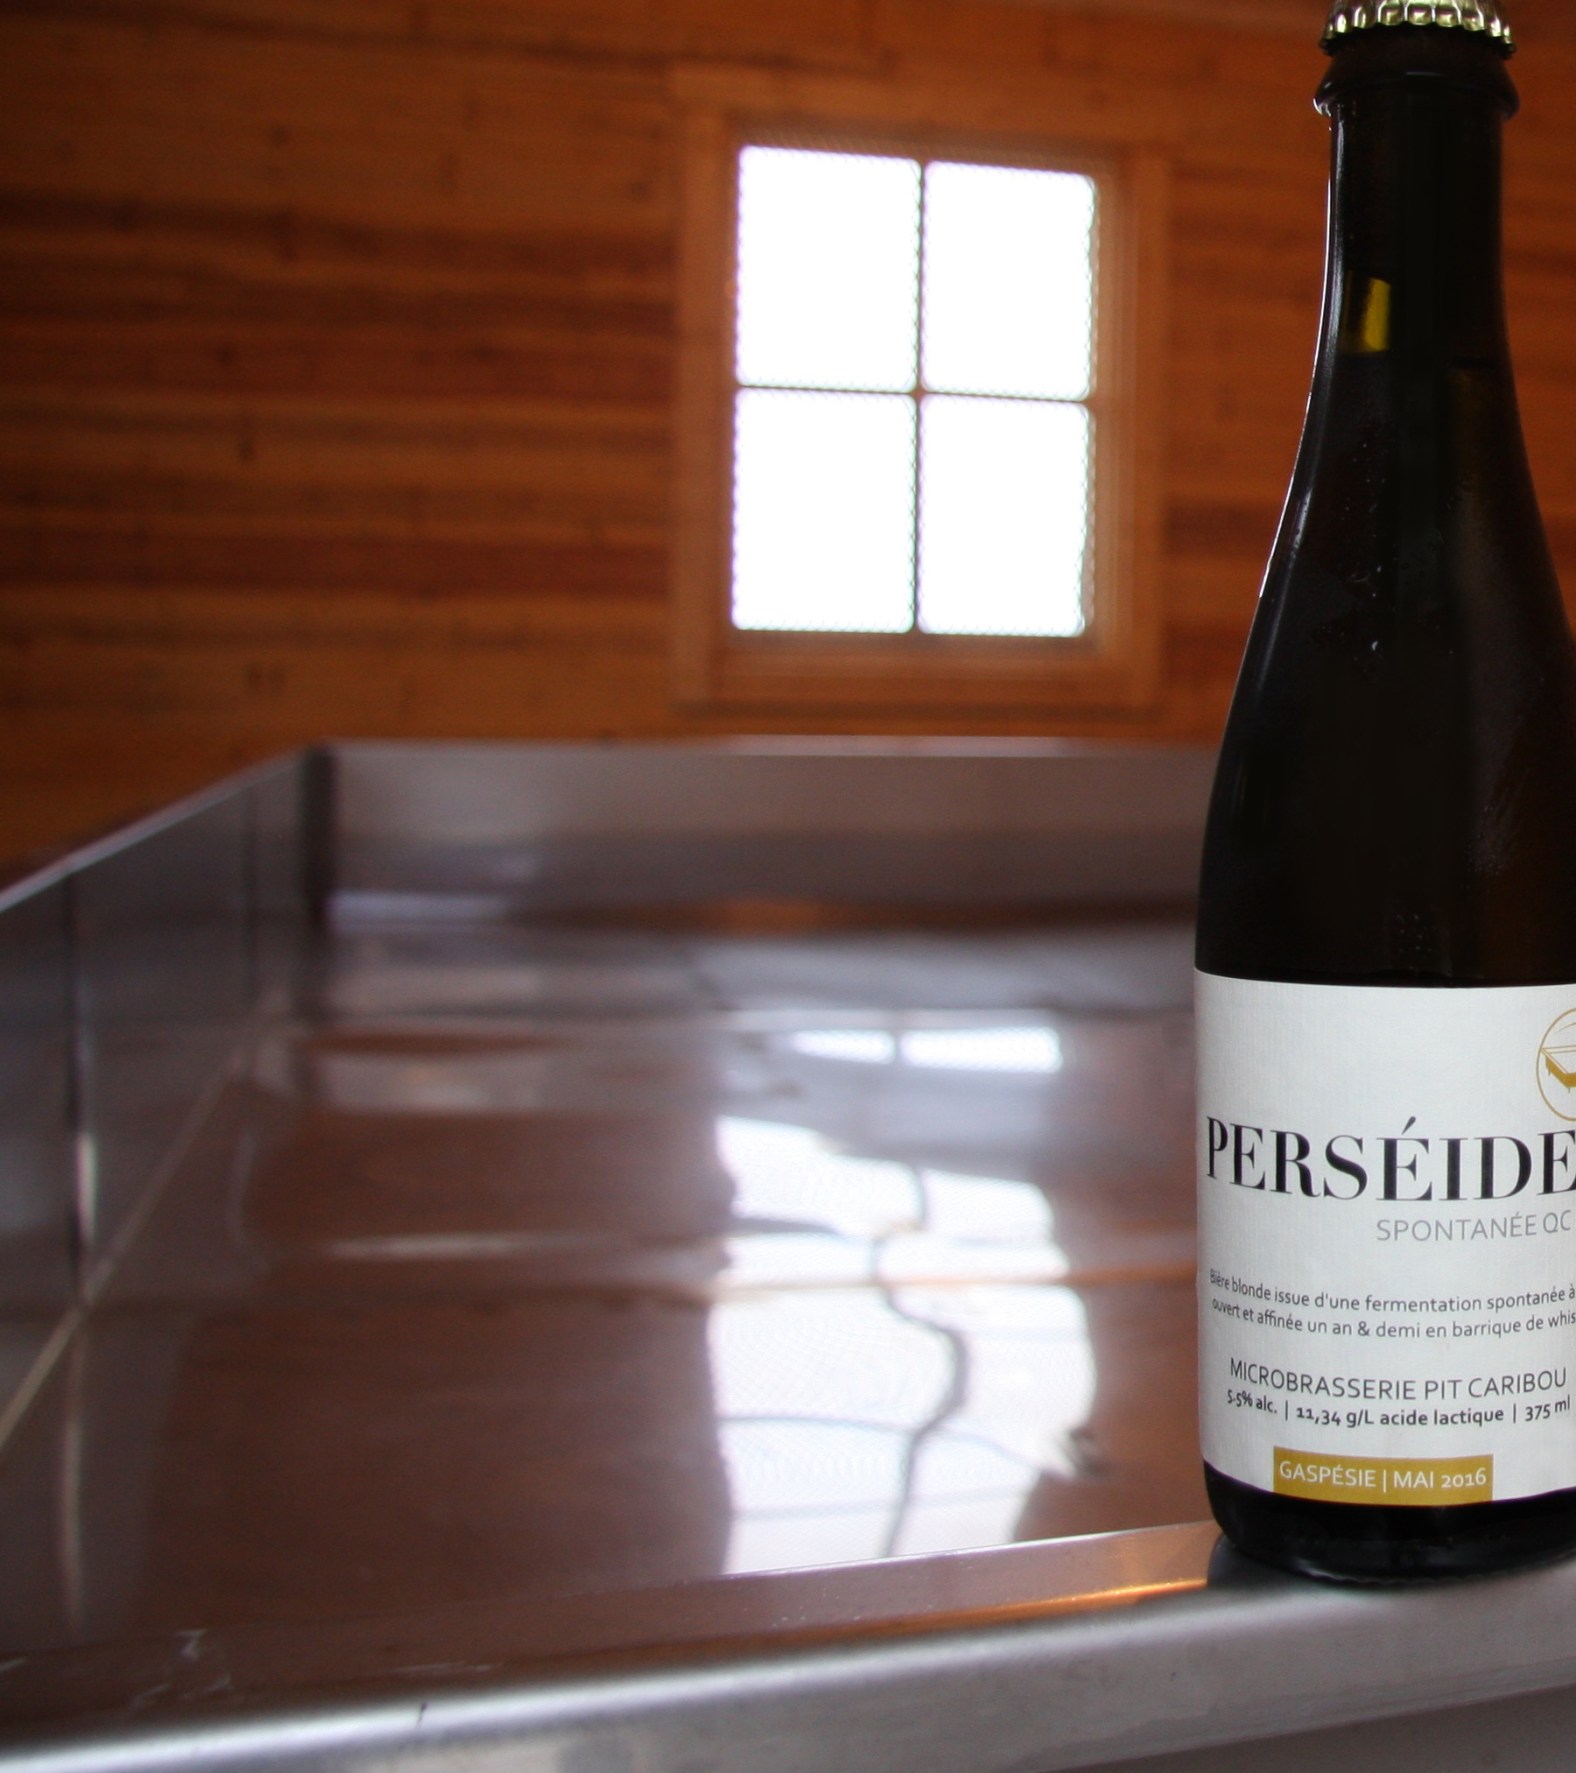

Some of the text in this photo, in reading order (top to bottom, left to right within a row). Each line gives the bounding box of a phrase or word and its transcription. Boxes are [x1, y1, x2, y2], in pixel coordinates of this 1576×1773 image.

[1376, 1211, 1537, 1242] SPONTANÉE
[1543, 1209, 1571, 1234] QC
[1232, 1276, 1271, 1301] blonde
[1274, 1286, 1310, 1307] issue
[1314, 1291, 1360, 1311] d'une
[1365, 1294, 1482, 1313] fermentation
[1487, 1285, 1565, 1313] spontanée
[1568, 1282, 1576, 1300] à
[1212, 1298, 1241, 1319] ouvert
[1242, 1308, 1255, 1322] et
[1257, 1309, 1303, 1331] affinée
[1307, 1321, 1327, 1334] un
[1332, 1322, 1352, 1336] an
[1357, 1320, 1370, 1337] &
[1376, 1321, 1420, 1338] demi
[1426, 1325, 1447, 1338] en
[1452, 1320, 1521, 1339] barrique
[1526, 1314, 1544, 1332] de
[1230, 1357, 1567, 1401] MICROBRASSERIE PIT CARIBOU
[1255, 1395, 1278, 1414] alc.
[1296, 1406, 1341, 1427] 11,34
[1345, 1408, 1375, 1429] g/L
[1380, 1409, 1428, 1426] acide
[1433, 1407, 1504, 1428] lactique
[1524, 1403, 1551, 1422] 375
[1554, 1394, 1571, 1413] ml
[1279, 1460, 1487, 1489] GASPÉSIE MAI 2016
